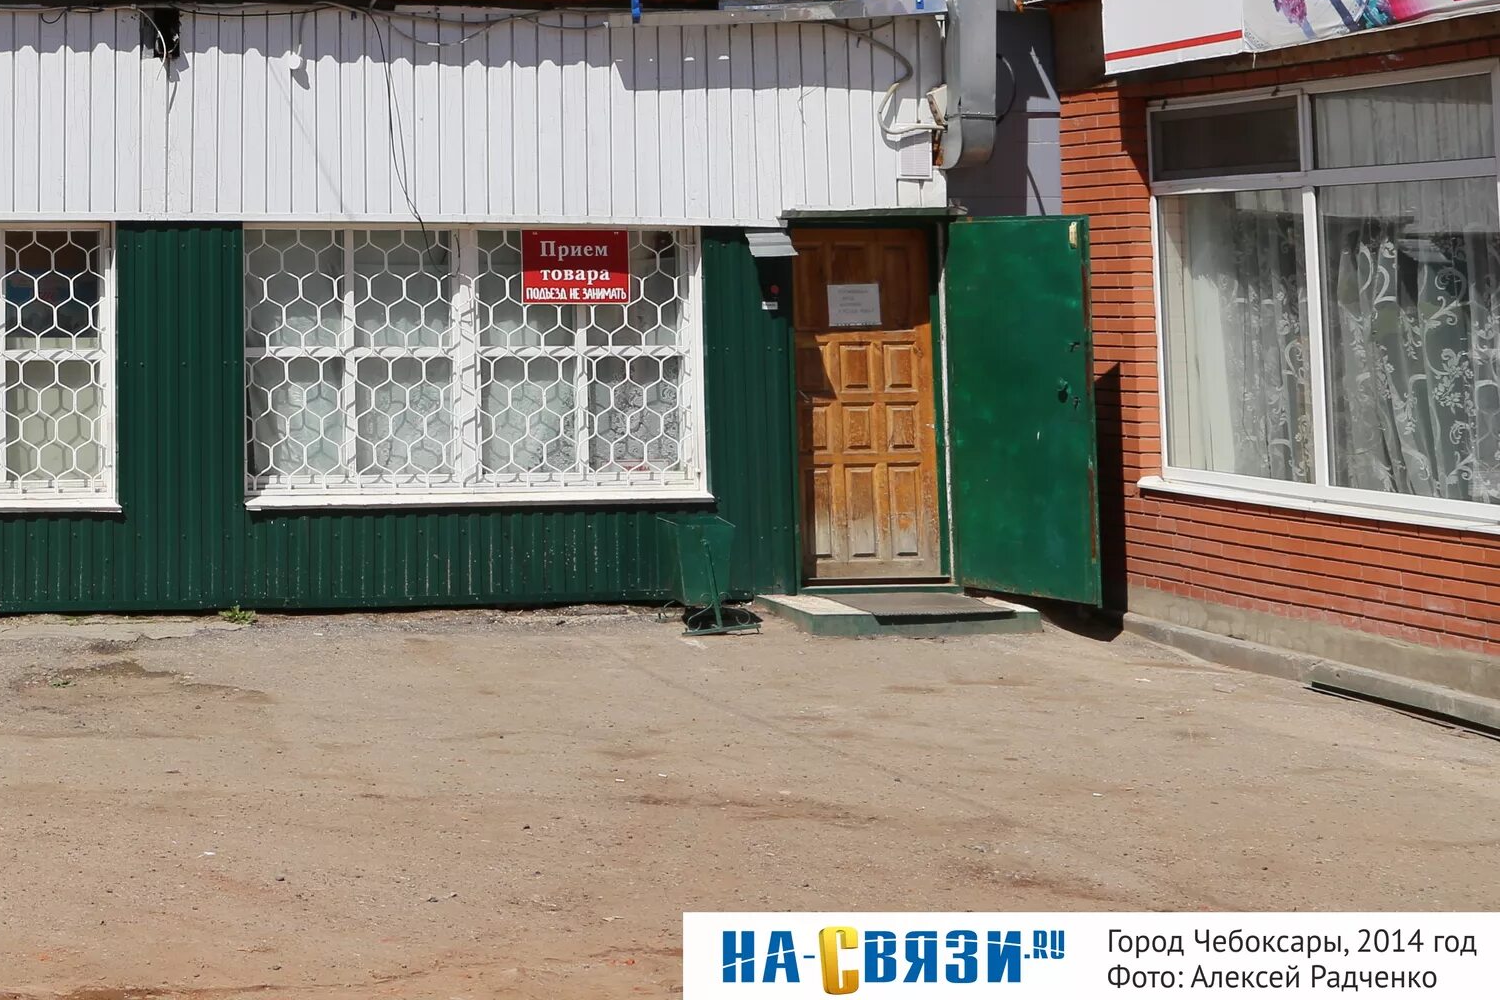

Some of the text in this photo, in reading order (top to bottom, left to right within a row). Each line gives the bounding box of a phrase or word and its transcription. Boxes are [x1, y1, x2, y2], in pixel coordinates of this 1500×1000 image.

[539, 240, 609, 262] Прием
[539, 269, 611, 285] товара
[526, 287, 627, 300] ПОДЪЕЗД НЕ ЗАНИМАТЬ
